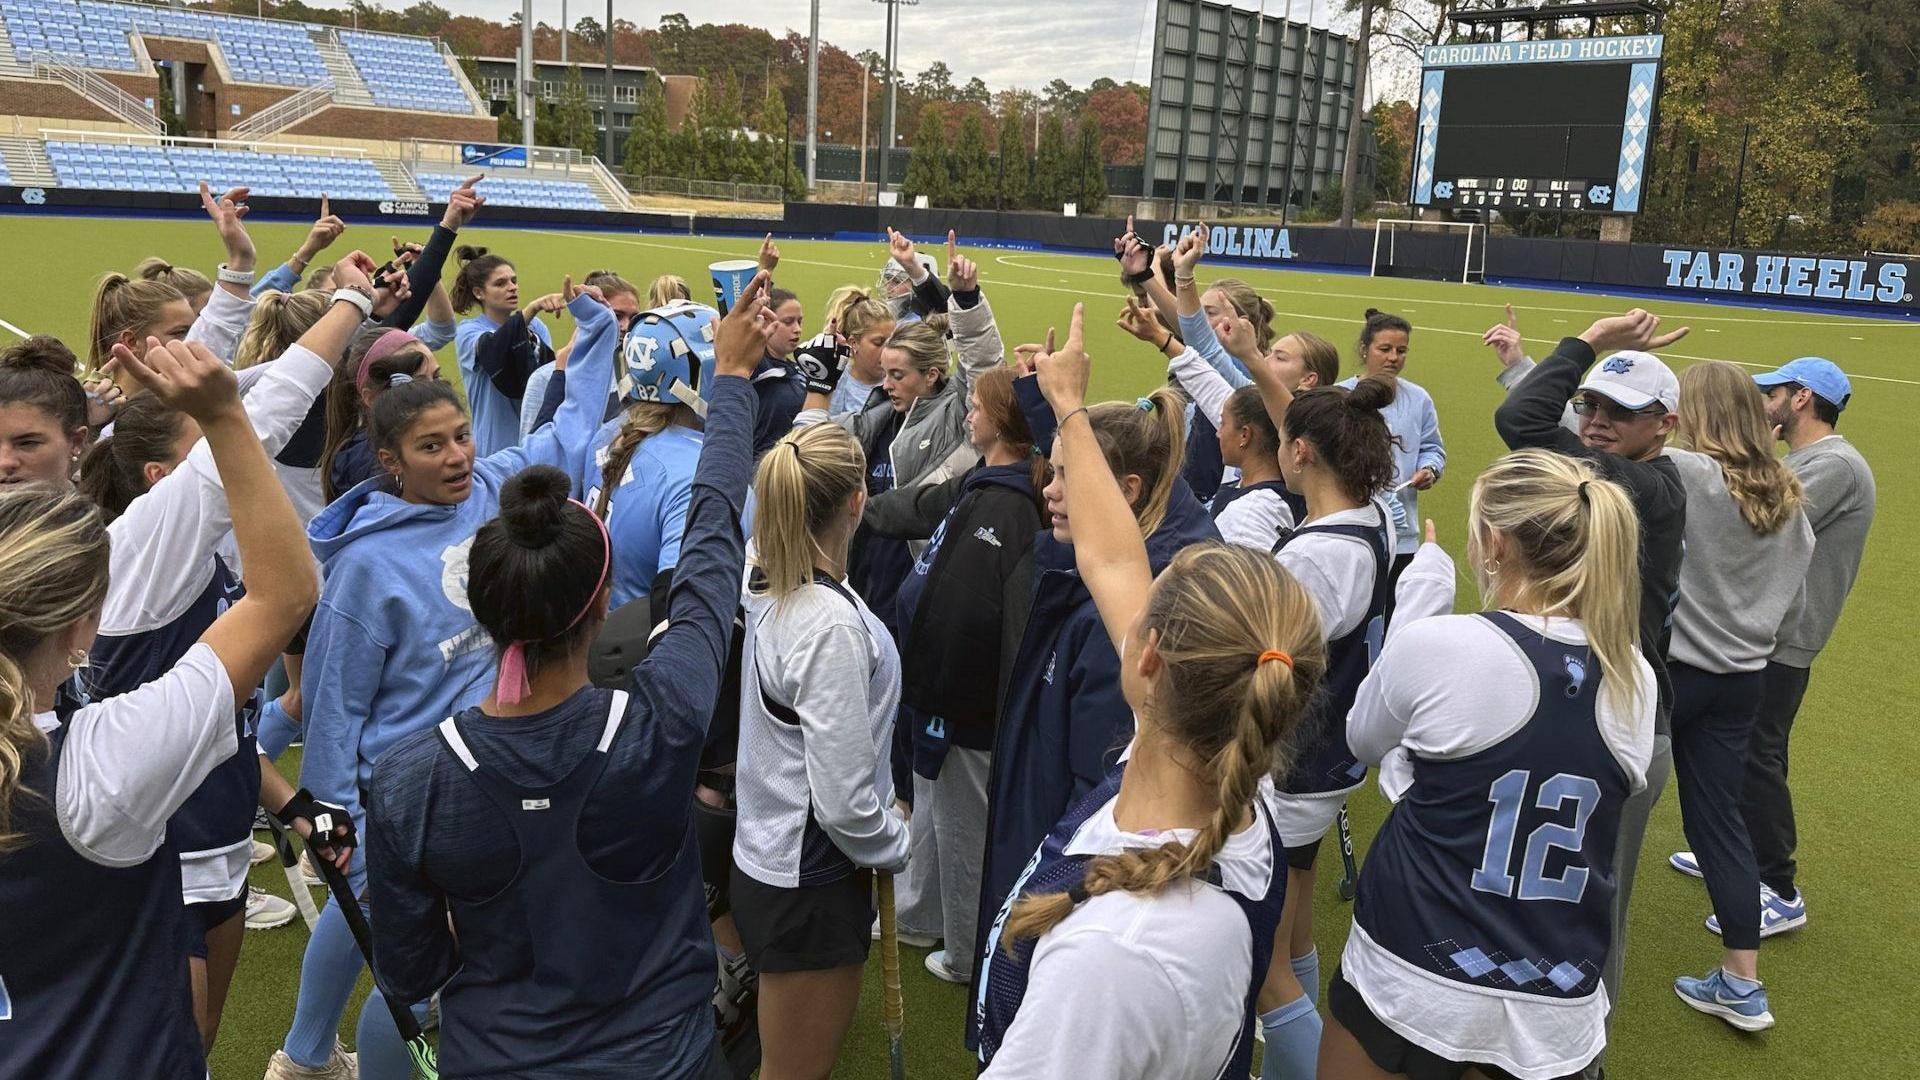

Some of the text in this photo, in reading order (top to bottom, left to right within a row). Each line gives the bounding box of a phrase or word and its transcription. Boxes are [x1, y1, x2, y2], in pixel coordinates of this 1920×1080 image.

[1427, 37, 1658, 64] CAROLINA FIELD HOCKEY
[394, 202, 429, 210] CAMPUS
[1163, 223, 1292, 258] COLINA
[1662, 249, 1908, 304] TAR HEELS
[636, 384, 661, 402] 82
[1470, 769, 1602, 904] 12
